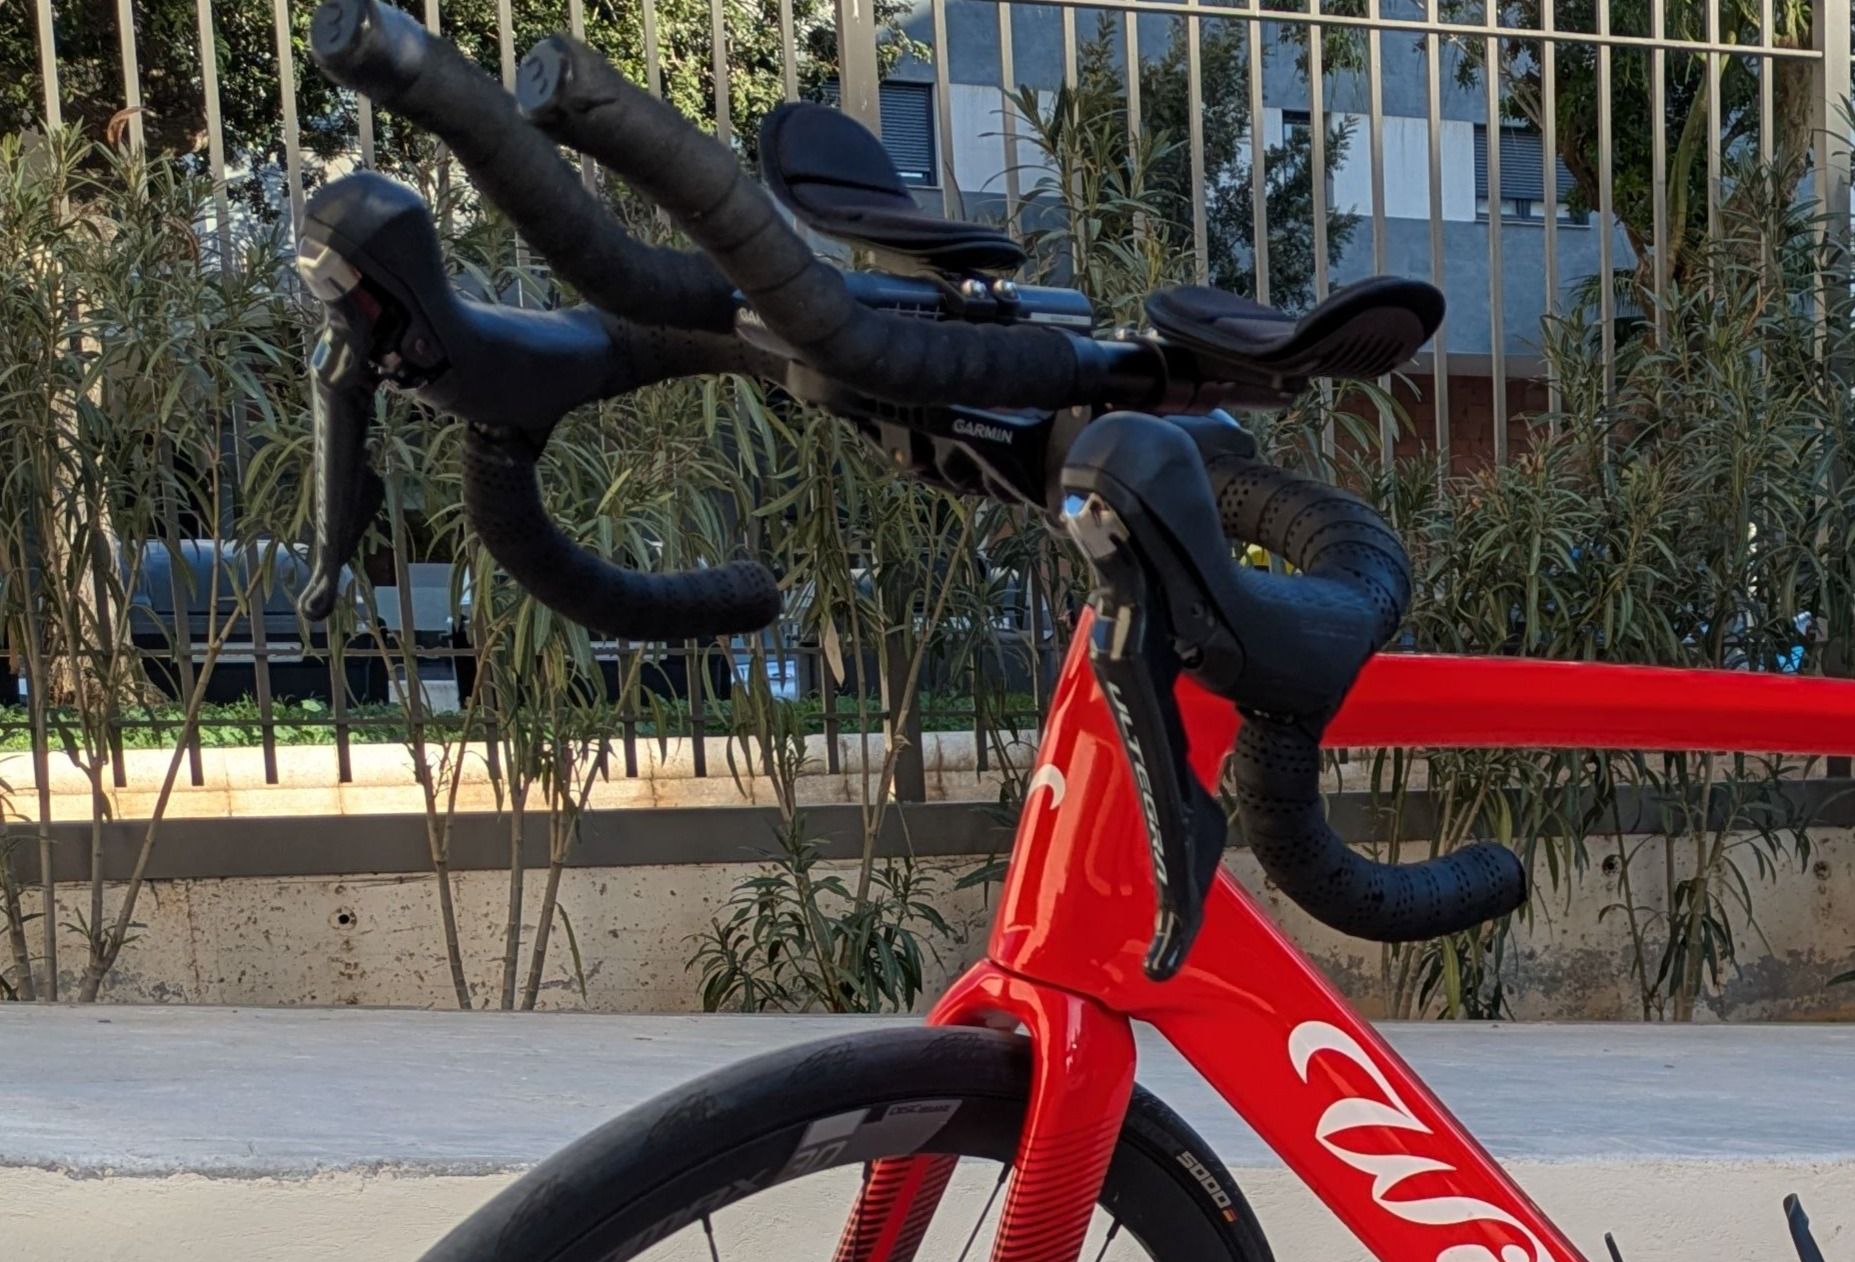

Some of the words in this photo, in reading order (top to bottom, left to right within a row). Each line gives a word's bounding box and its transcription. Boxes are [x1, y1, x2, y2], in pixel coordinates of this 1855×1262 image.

[952, 418, 1014, 446] GARMIN
[1105, 680, 1169, 886] ULTEGRA
[1175, 1150, 1232, 1209] 5000
